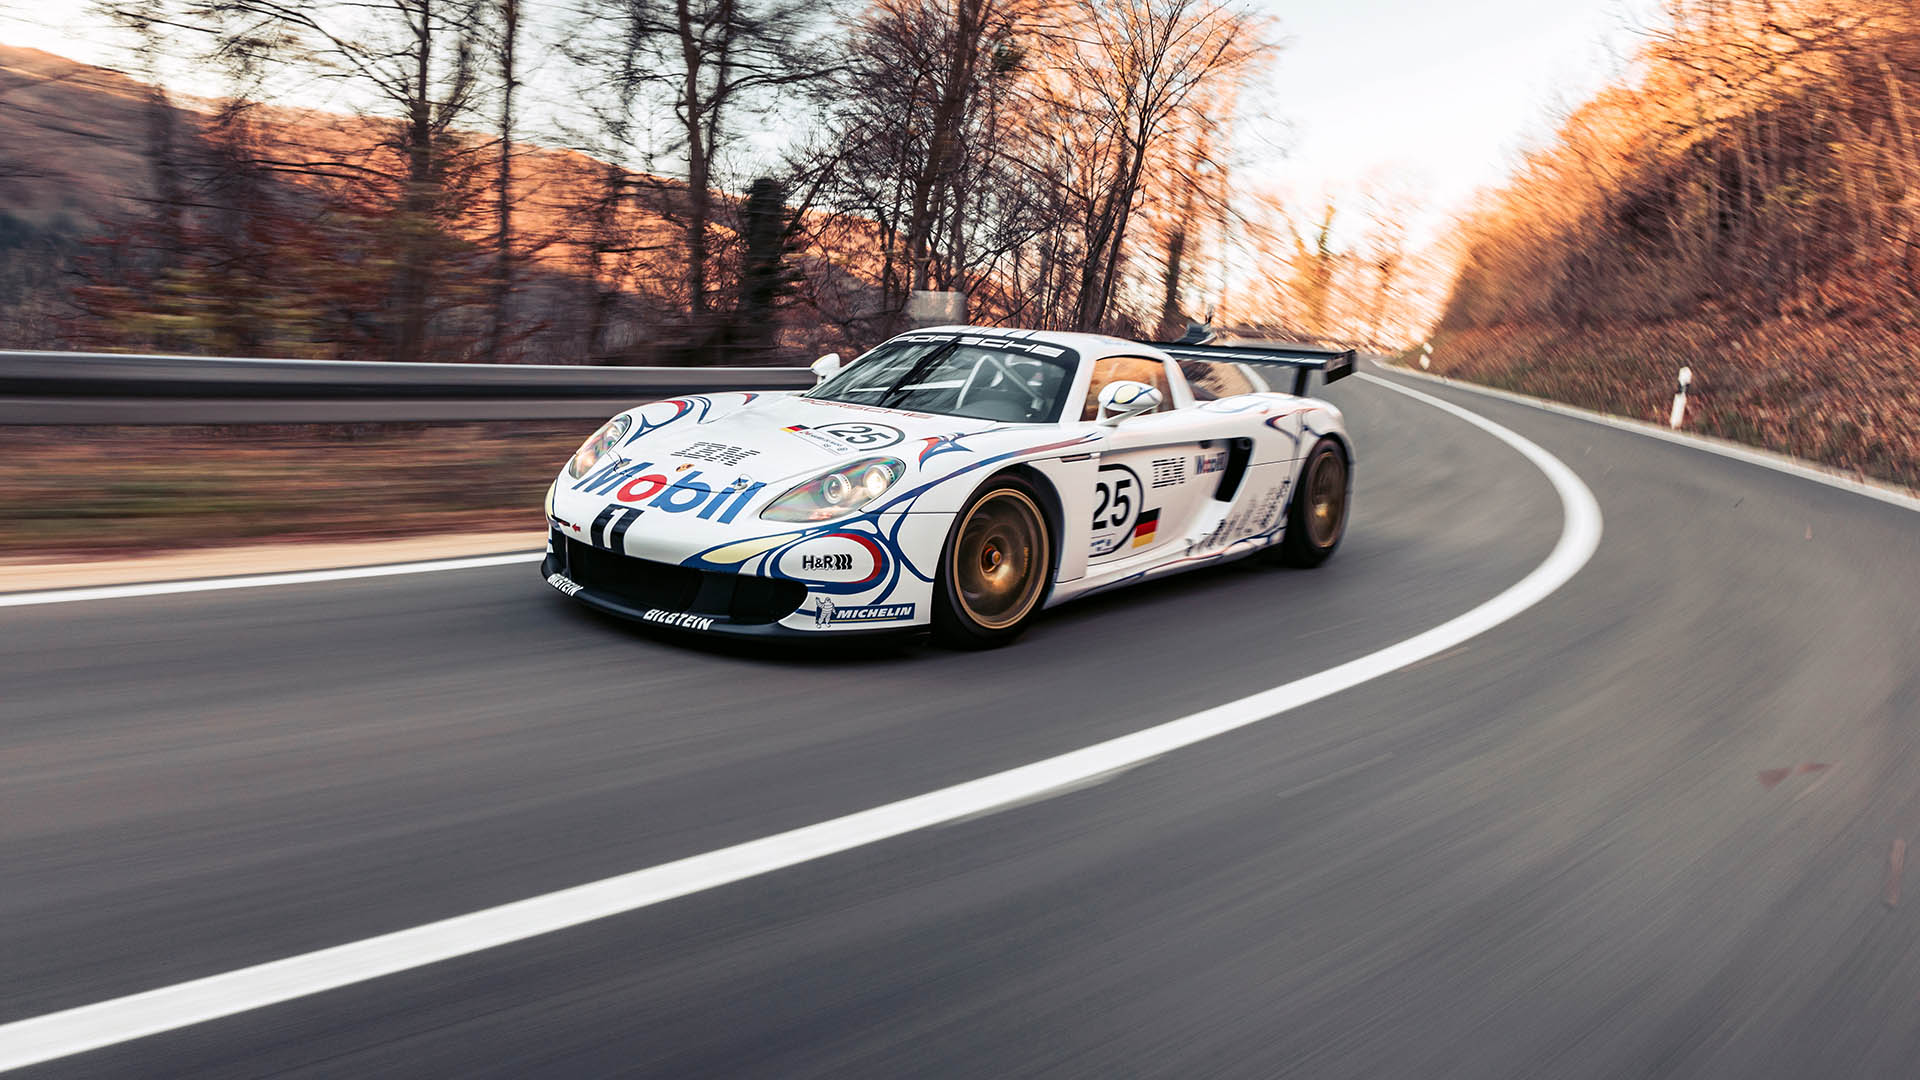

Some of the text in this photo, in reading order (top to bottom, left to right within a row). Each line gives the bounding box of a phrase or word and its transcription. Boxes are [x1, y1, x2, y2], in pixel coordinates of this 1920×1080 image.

[888, 335, 1065, 358] PORSCHE
[828, 426, 892, 444] 25
[670, 441, 760, 466] IBM
[1152, 457, 1186, 488] IBM
[571, 458, 767, 524] Mobil
[1092, 479, 1132, 530] 25
[802, 555, 834, 570] H&R
[642, 608, 714, 631] BILSTEIN
[836, 606, 912, 619] MICHELIN
